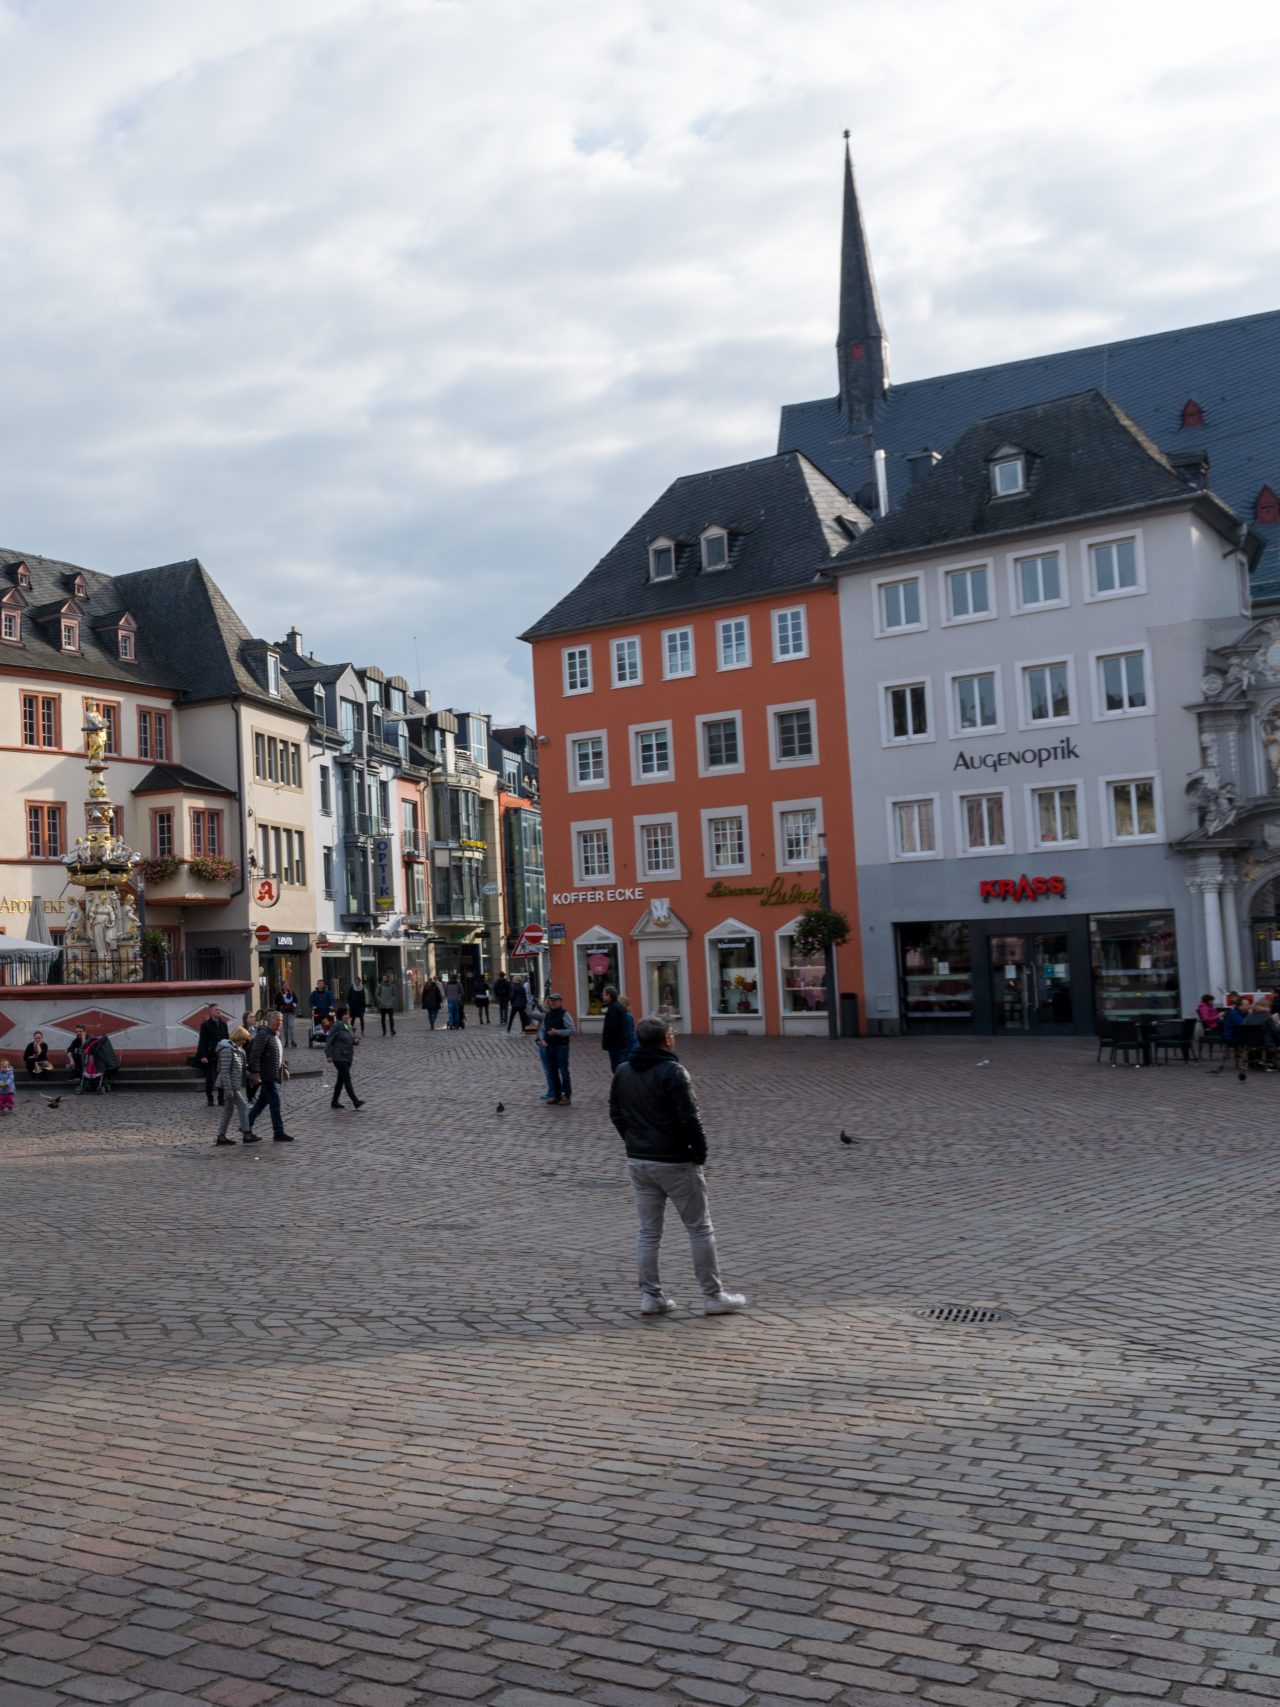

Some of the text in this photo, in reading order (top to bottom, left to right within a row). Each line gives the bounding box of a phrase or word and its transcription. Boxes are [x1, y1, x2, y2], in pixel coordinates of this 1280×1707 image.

[376, 841, 390, 897] OPTIK
[552, 887, 644, 905] KOFFER ECKE
[759, 876, 822, 906] Ludwi
[979, 873, 1066, 903] KRASS
